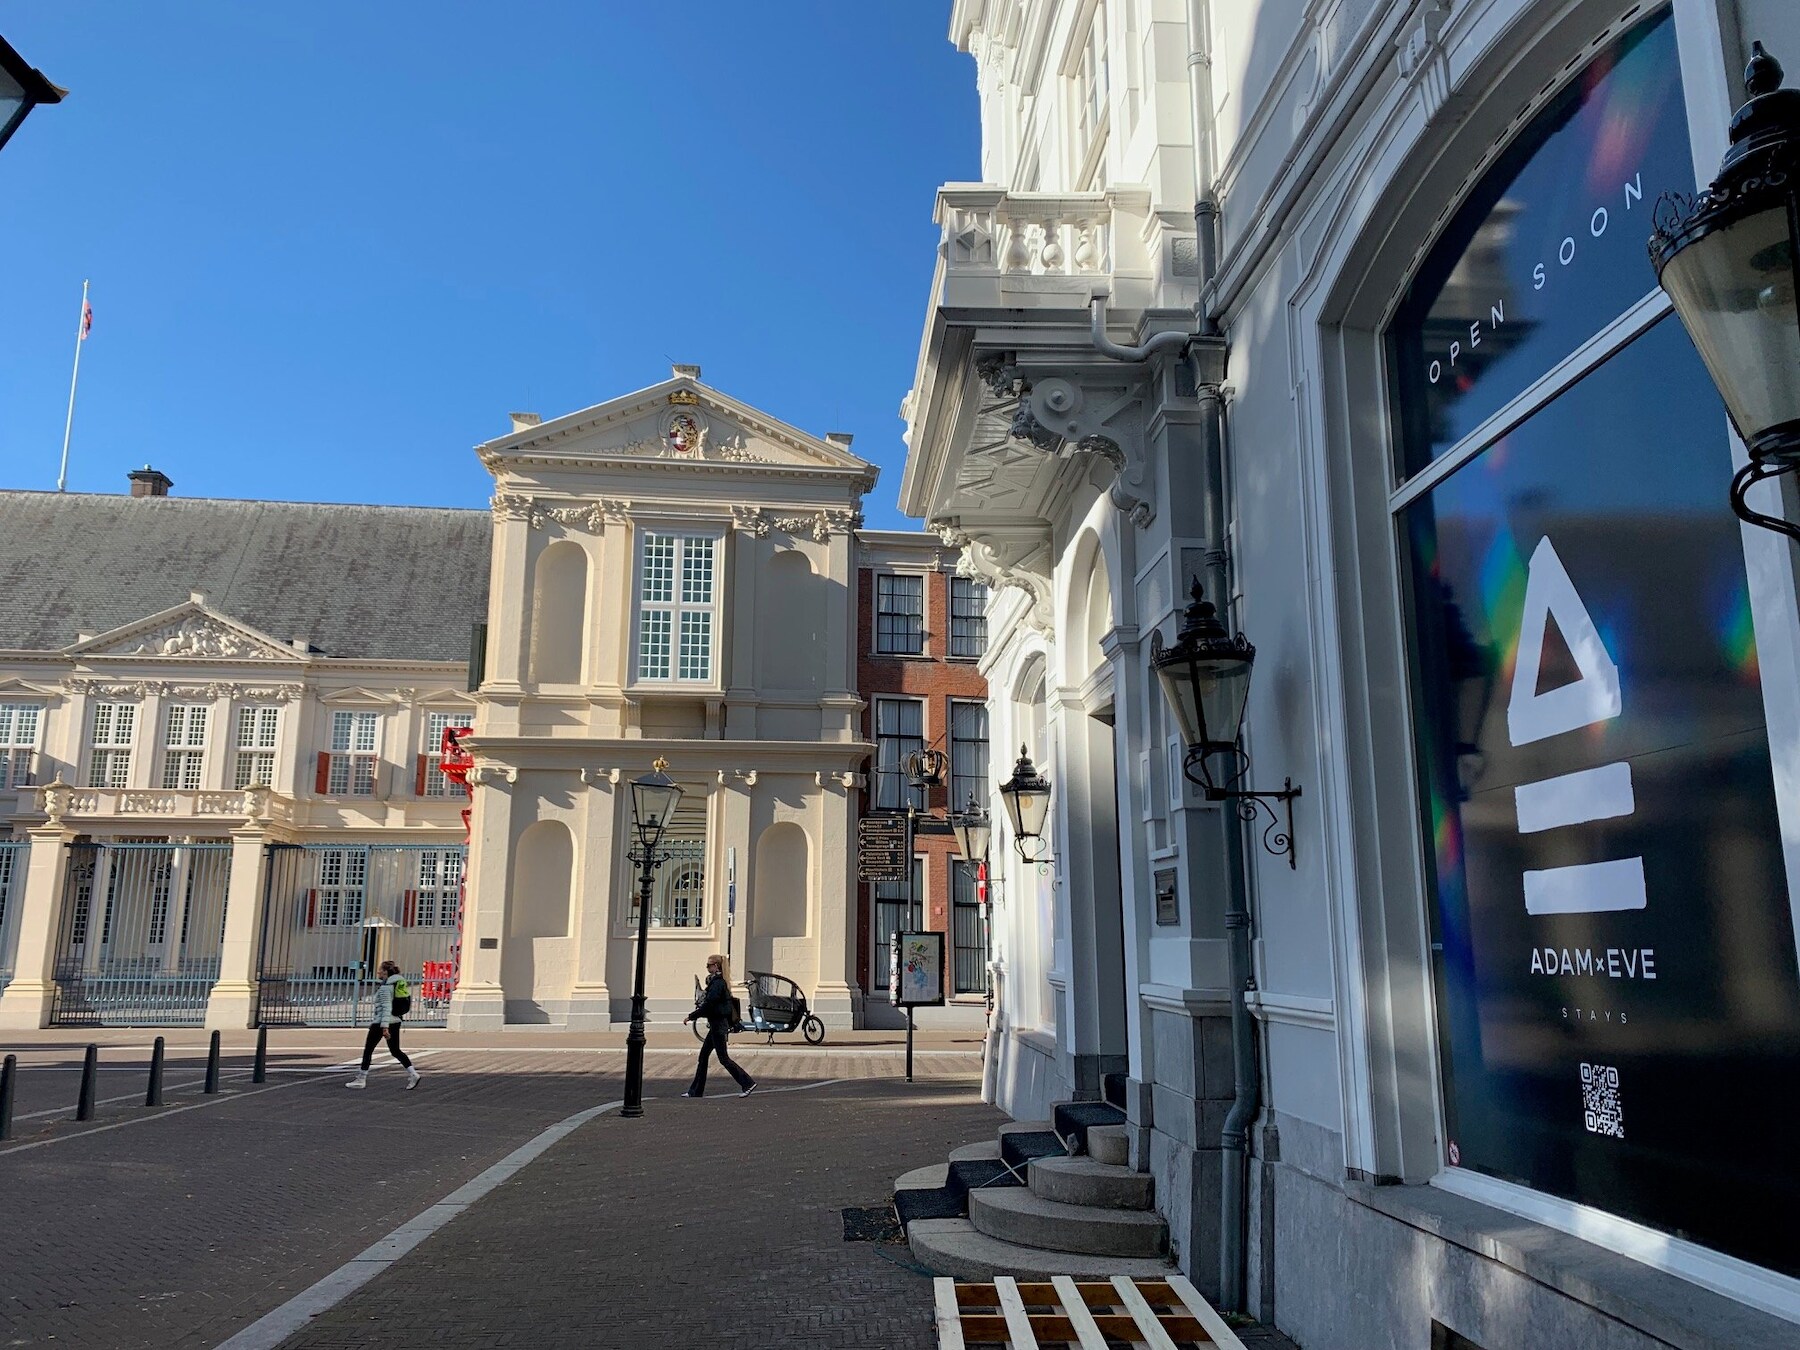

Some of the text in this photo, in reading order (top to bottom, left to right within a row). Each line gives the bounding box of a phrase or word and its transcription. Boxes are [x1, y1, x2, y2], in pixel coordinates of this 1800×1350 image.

[1429, 172, 1643, 384] OPEN SOON
[1561, 1007, 1627, 1024] STAYS
